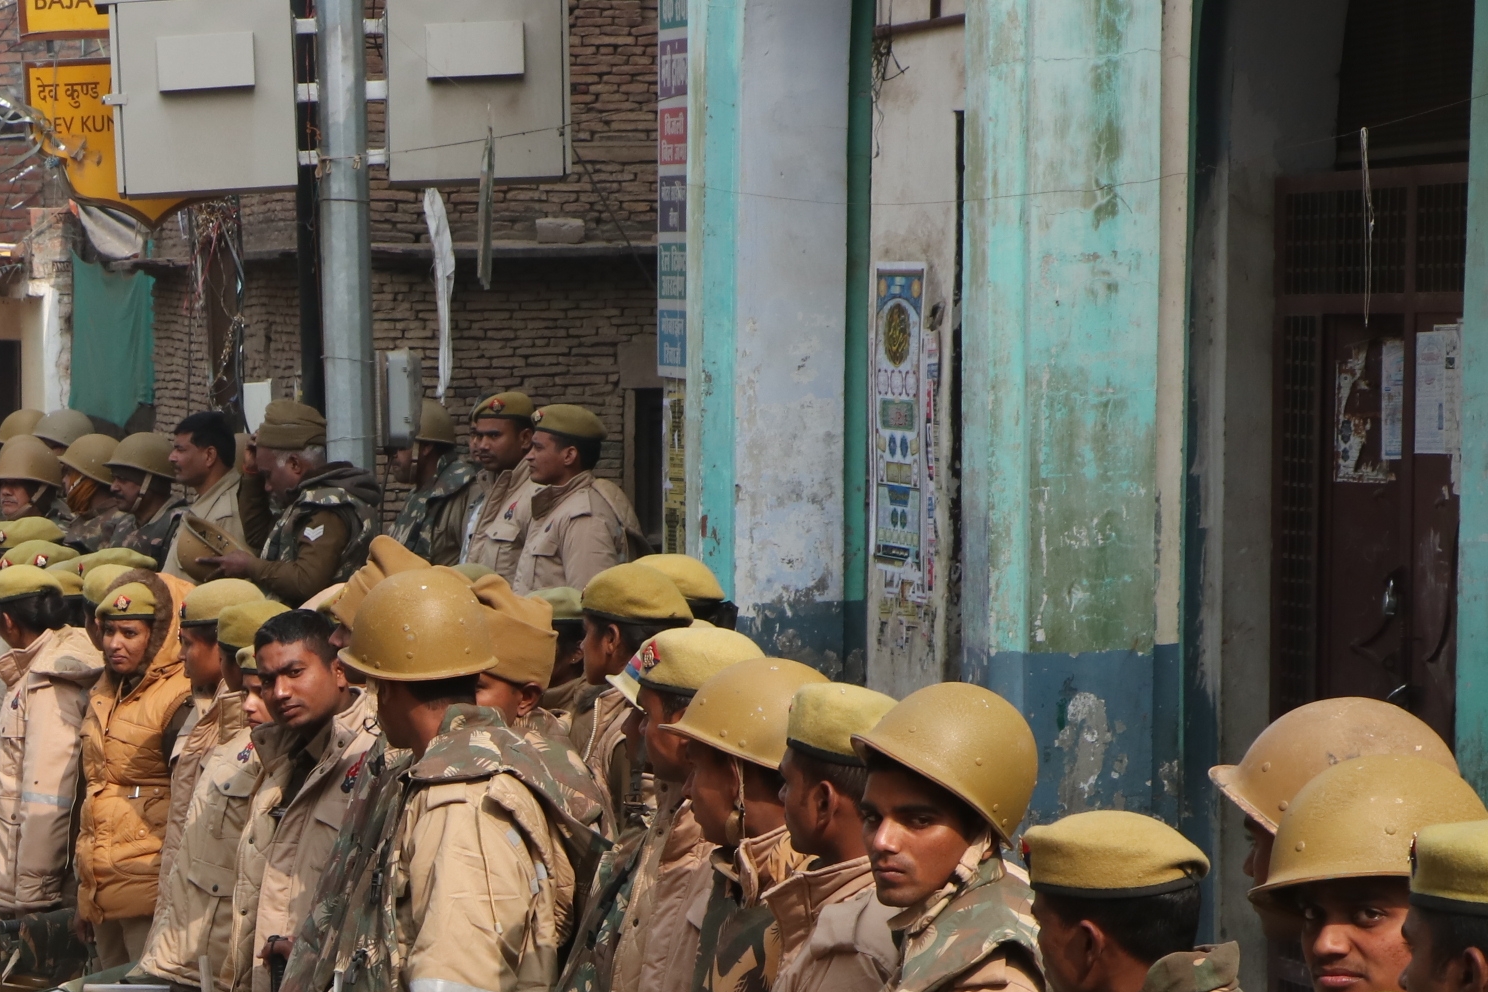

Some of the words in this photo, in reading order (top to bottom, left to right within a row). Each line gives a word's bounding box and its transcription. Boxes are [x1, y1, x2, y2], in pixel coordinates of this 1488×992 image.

[34, 0, 93, 10] BAJA
[36, 77, 59, 103] देव
[64, 81, 100, 109] कुण्ड
[81, 115, 114, 133] KUN
